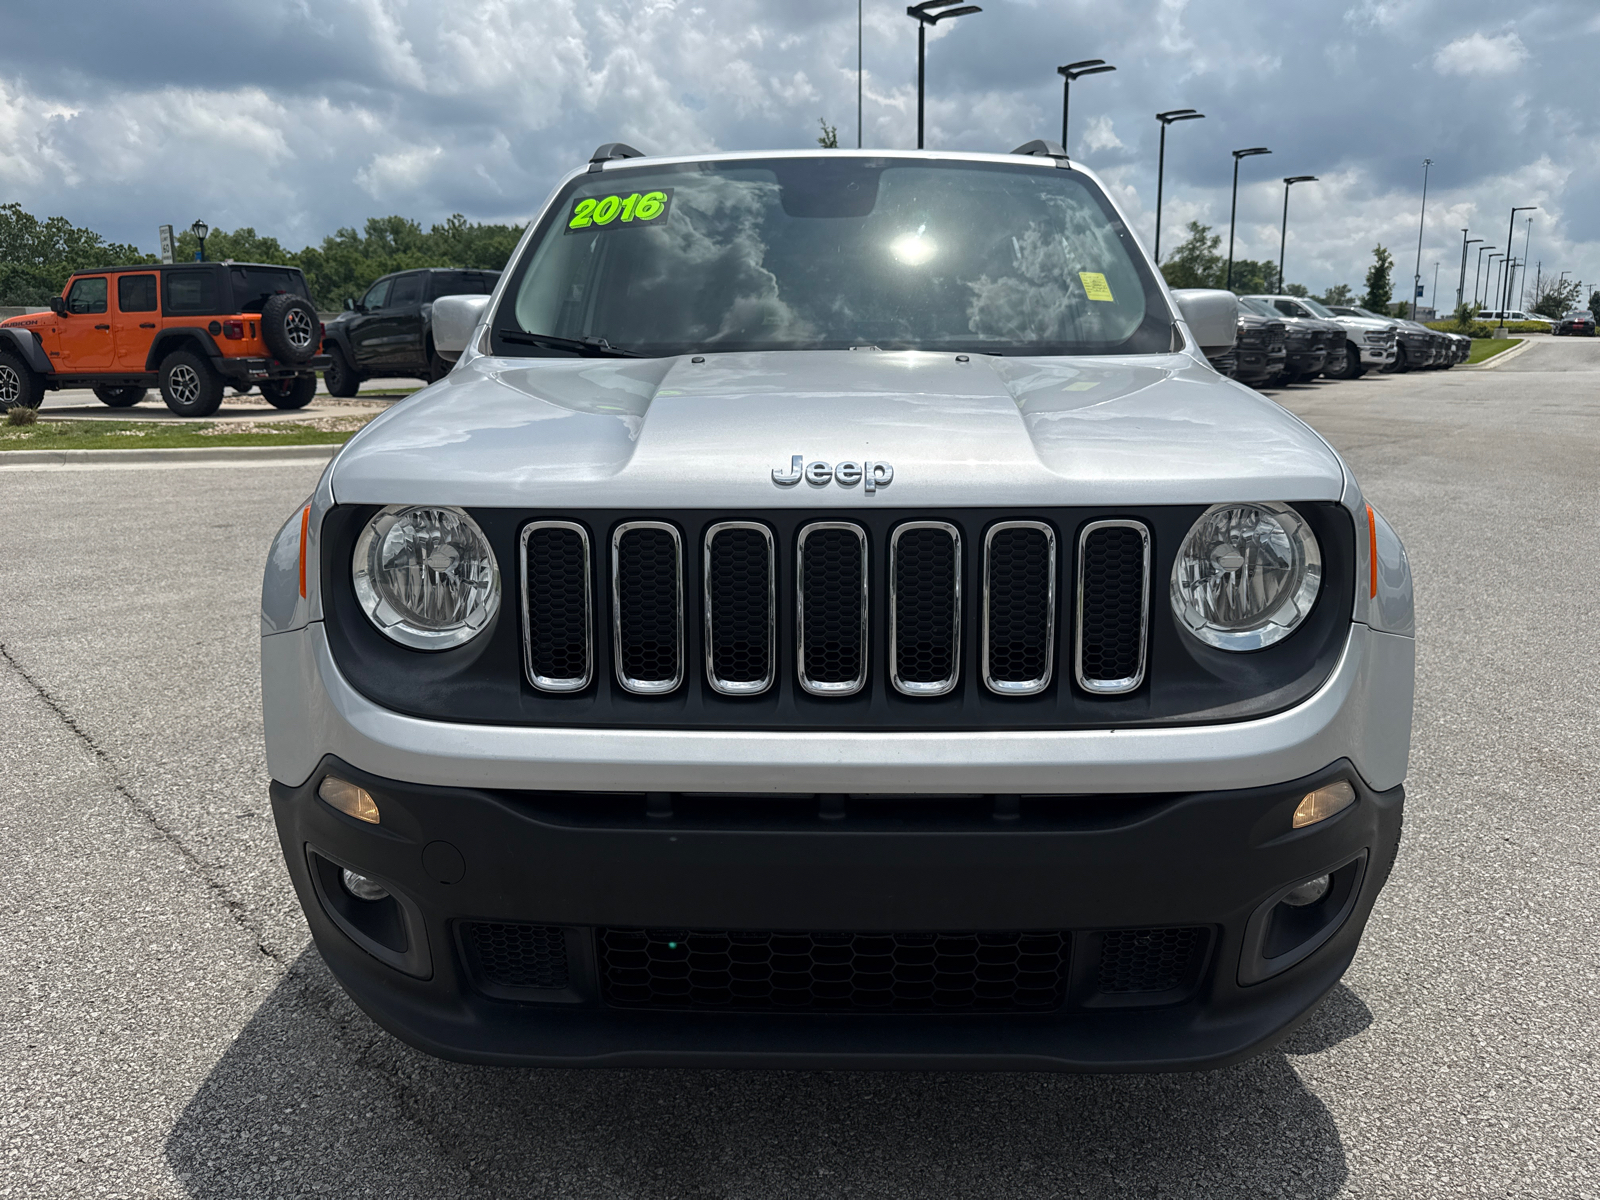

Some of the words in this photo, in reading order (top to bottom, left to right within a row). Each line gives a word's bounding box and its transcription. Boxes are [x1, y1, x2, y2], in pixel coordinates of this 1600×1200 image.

[569, 191, 668, 229] 2016
[1, 320, 38, 328] RUBICON
[771, 455, 894, 493] Jeep
